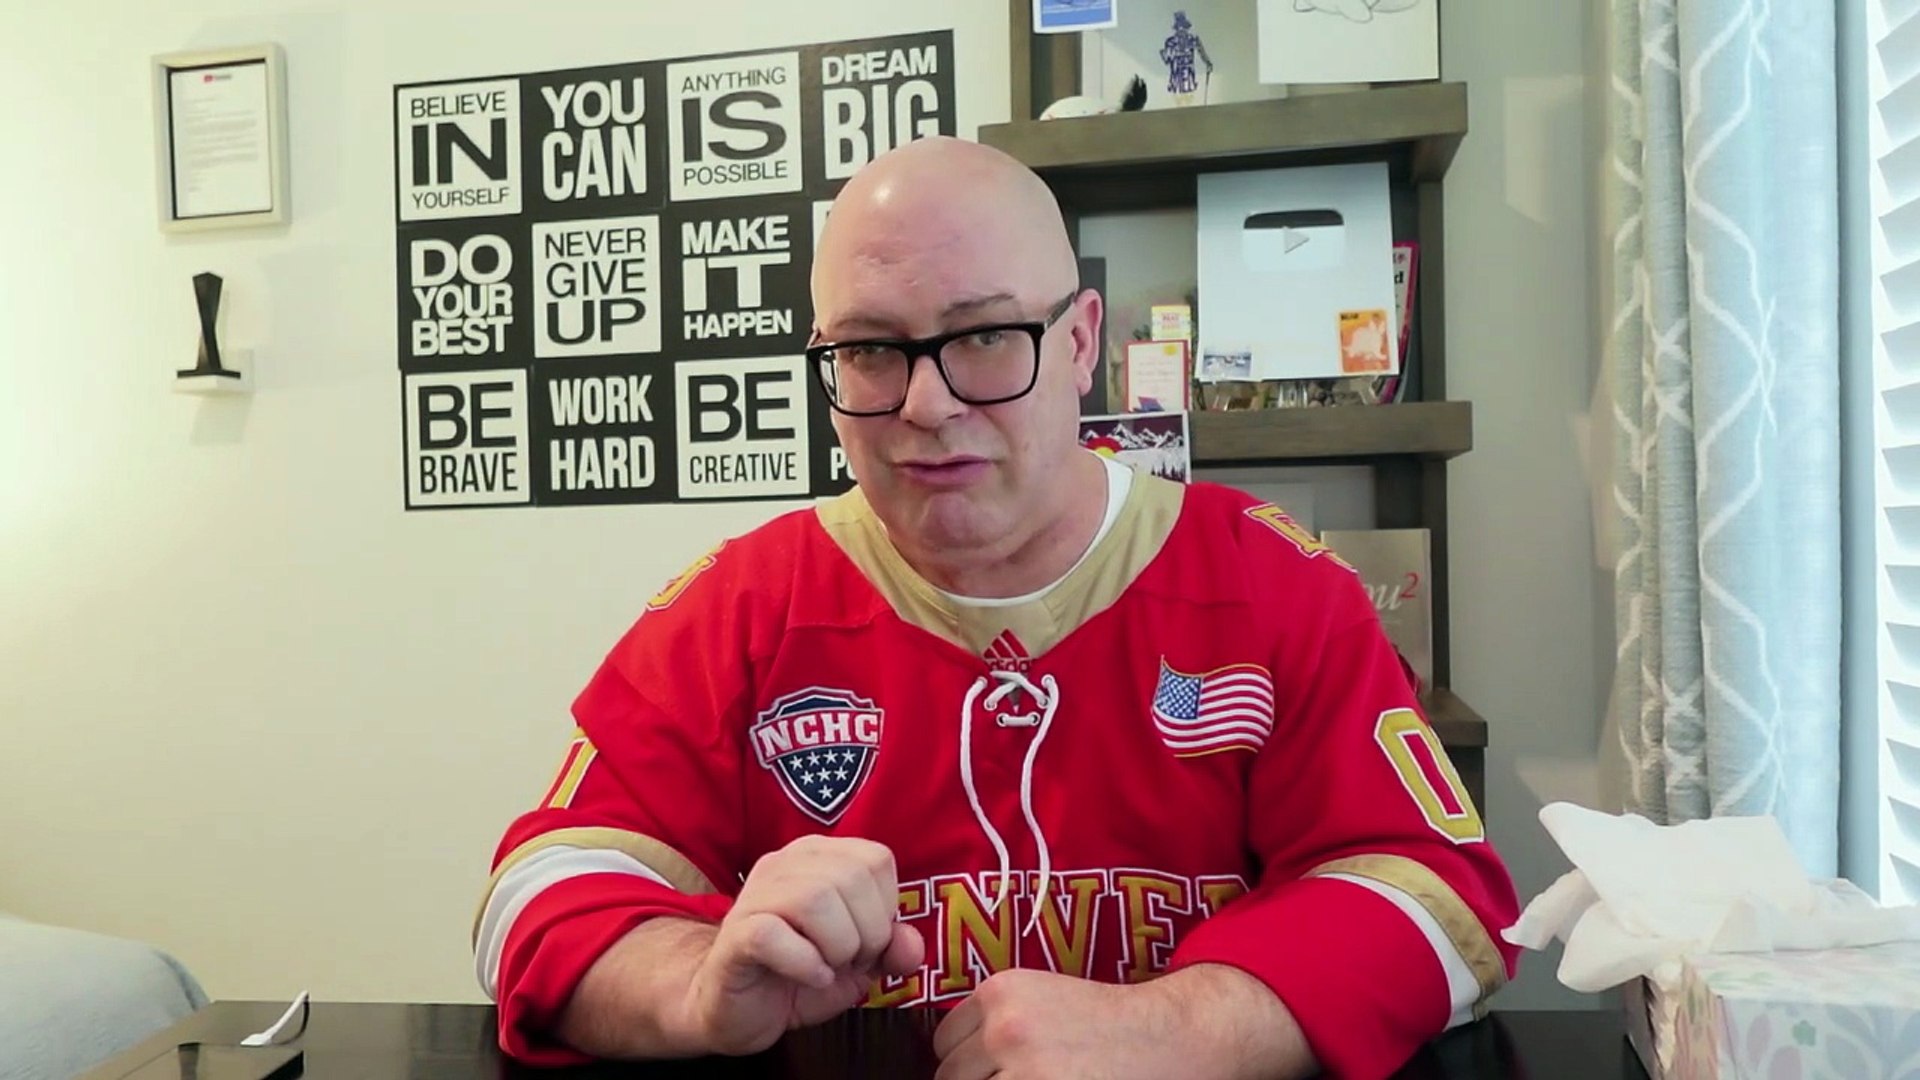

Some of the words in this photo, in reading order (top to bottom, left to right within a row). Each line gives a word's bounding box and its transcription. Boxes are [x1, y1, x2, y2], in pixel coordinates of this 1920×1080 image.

[681, 66, 787, 93] ANYTHING
[822, 45, 937, 85] DREAM
[411, 91, 506, 118] BELIEVE
[541, 78, 646, 129] YOU
[682, 90, 787, 162] IS
[823, 80, 940, 180] BIG
[412, 117, 508, 186] IN
[542, 123, 648, 202] CAN
[683, 160, 788, 186] POSSIBLE
[412, 187, 510, 209] YOURSELF
[545, 227, 646, 257] NEVER
[682, 216, 789, 255] MAKE
[410, 234, 513, 287] DO
[547, 257, 647, 298] GIVE
[683, 252, 791, 312] IT
[413, 282, 513, 320] YOUR
[547, 297, 646, 345] UP
[412, 317, 514, 356] BEST
[684, 309, 793, 340] HAPPEN
[418, 381, 517, 450] BE
[549, 374, 653, 426] WORK
[689, 370, 796, 443] BE
[420, 452, 518, 494] BRAVE
[550, 434, 656, 491] HARD
[690, 451, 797, 484] CREATIVE
[757, 712, 879, 758] NCHC
